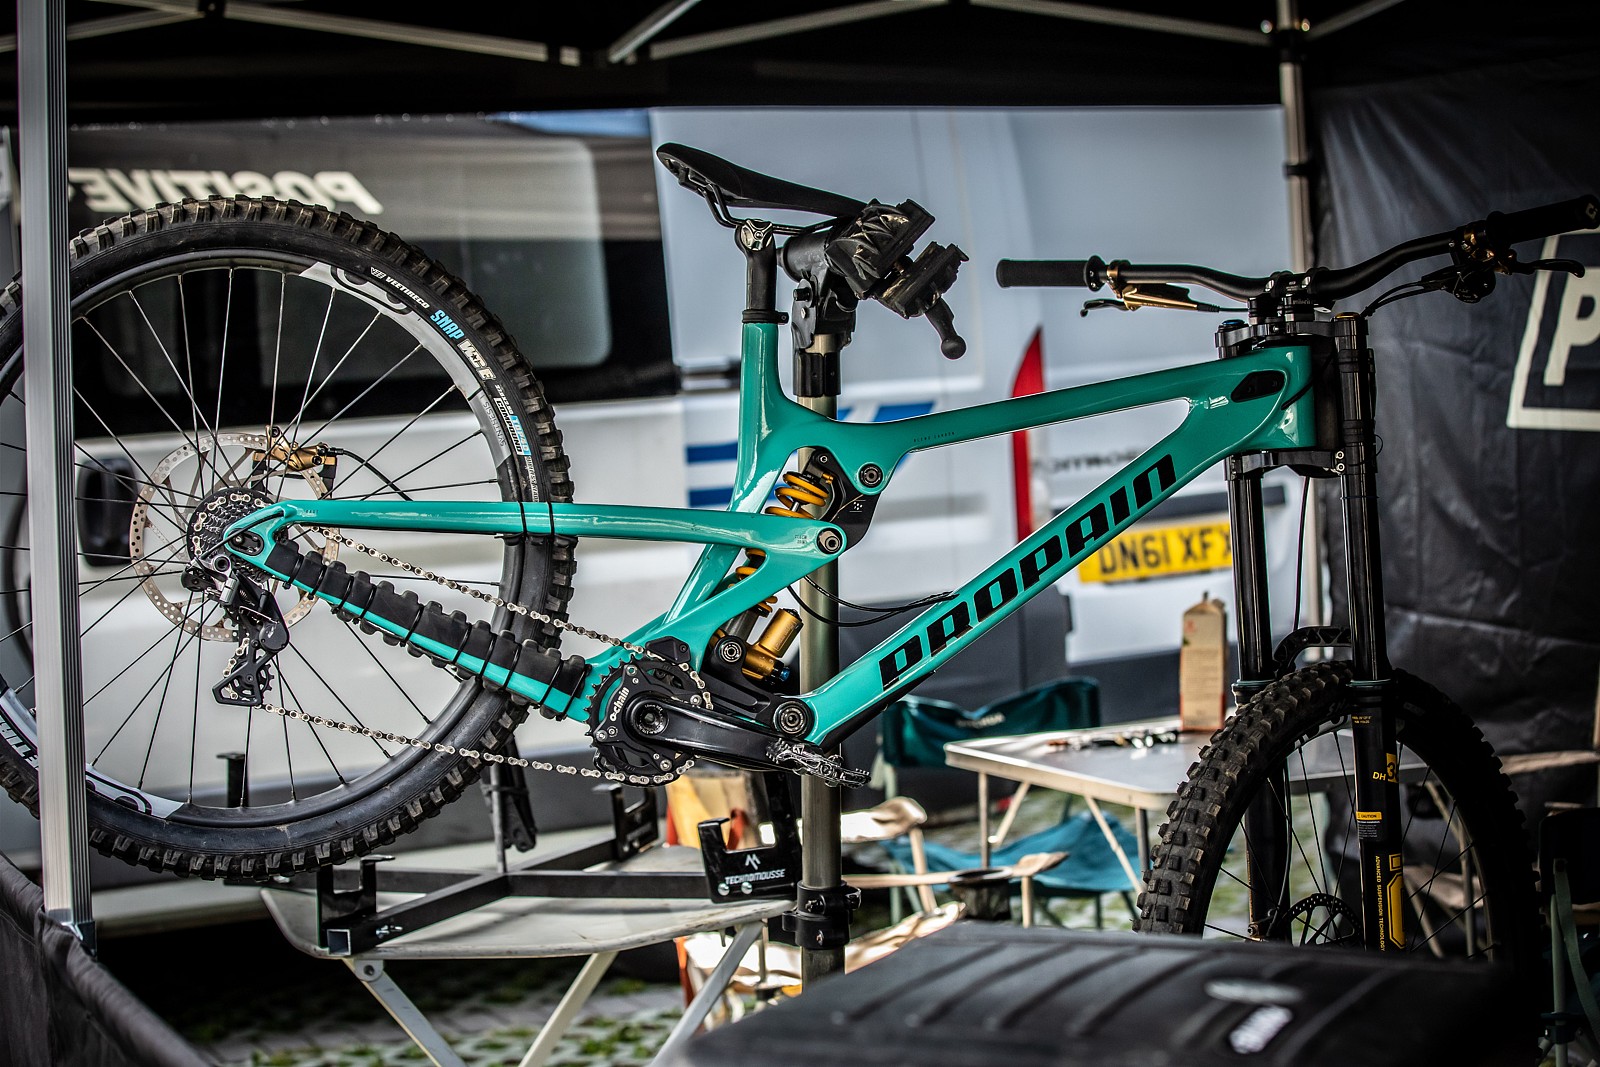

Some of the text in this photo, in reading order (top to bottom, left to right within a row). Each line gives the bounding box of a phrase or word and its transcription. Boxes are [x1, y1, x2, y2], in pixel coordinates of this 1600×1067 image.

[429, 309, 465, 340] SNAP
[496, 400, 523, 454] COMPOUND
[1099, 534, 1171, 574] DN61
[724, 868, 786, 885] TECHNOMOUSSE
